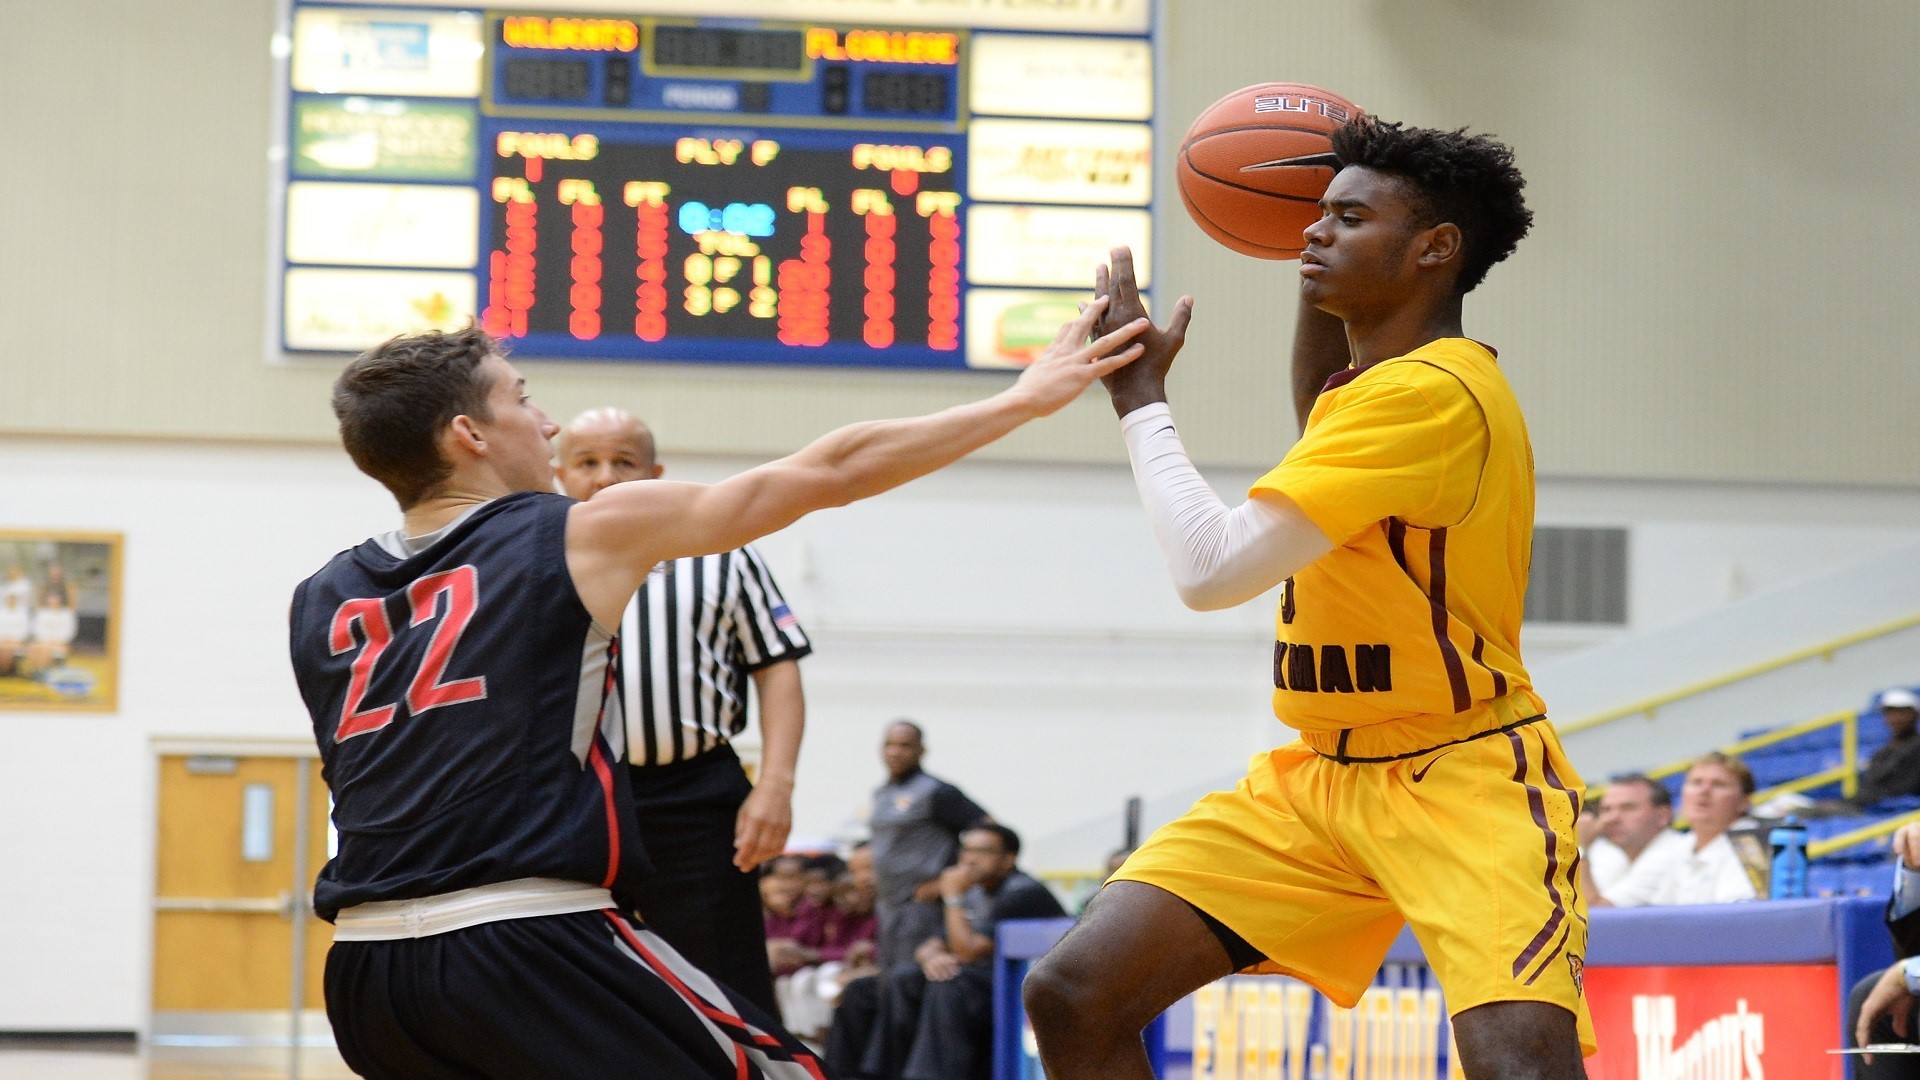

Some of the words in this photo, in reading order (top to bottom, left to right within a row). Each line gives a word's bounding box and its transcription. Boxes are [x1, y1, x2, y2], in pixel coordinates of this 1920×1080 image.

[504, 16, 638, 51] WILDCATS
[497, 131, 599, 160] FOULS
[854, 144, 953, 173] FOULS
[328, 564, 488, 744] 22
